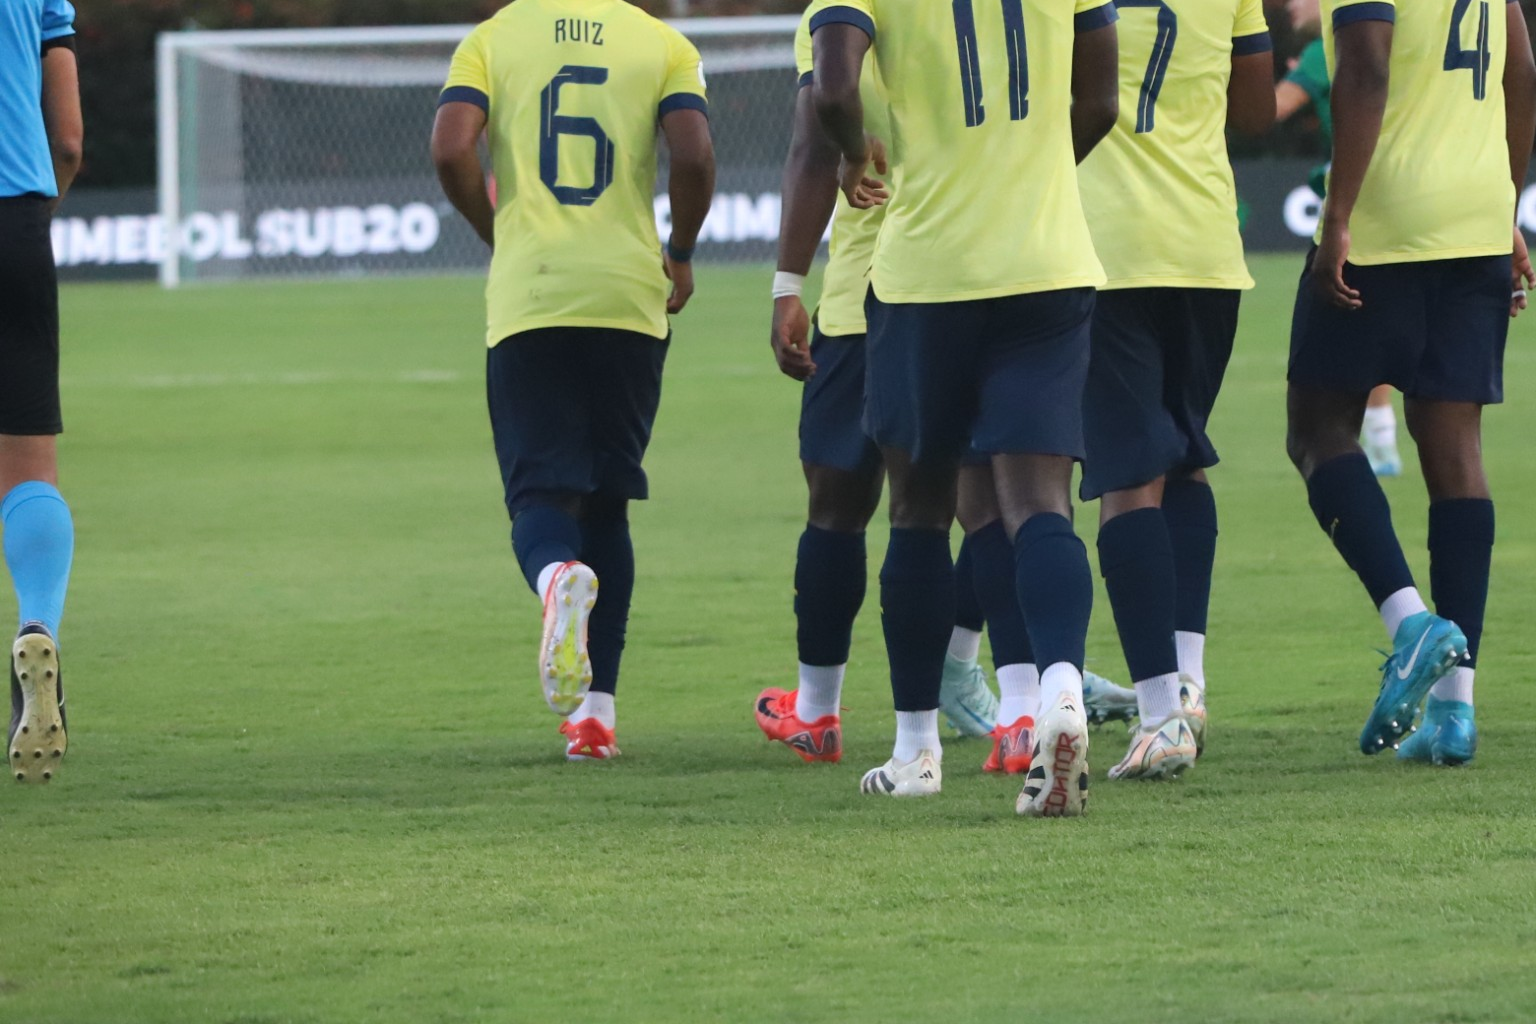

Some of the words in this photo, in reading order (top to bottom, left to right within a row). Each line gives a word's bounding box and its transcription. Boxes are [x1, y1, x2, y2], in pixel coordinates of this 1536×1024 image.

[555, 18, 604, 46] RUIZ
[539, 64, 615, 207] 6
[256, 202, 440, 257] SUB20
